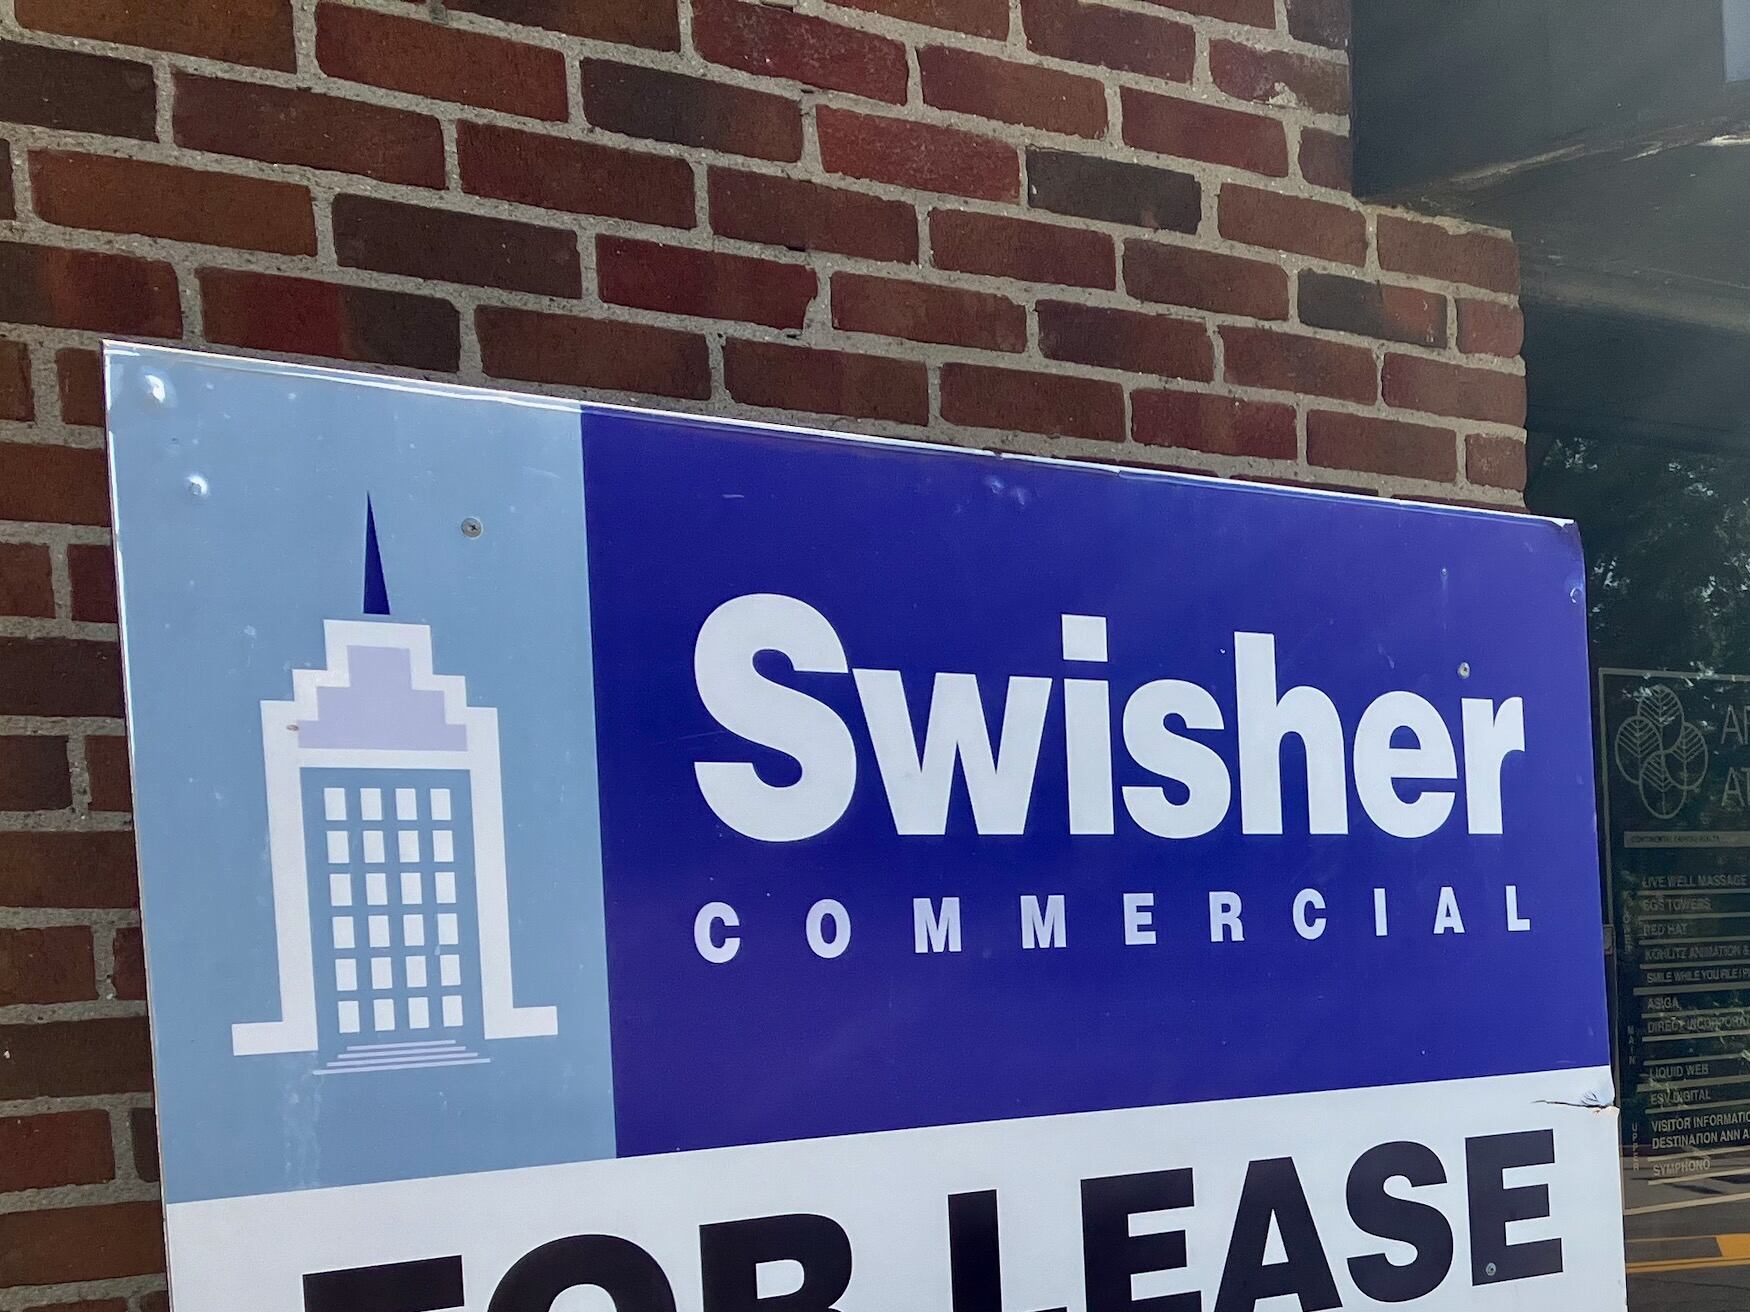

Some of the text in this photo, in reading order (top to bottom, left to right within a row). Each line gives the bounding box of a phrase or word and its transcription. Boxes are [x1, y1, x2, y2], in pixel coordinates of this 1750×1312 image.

[694, 593, 1526, 842] Swisher
[1667, 875, 1697, 888] WELL
[1698, 874, 1748, 887] MASSAGE
[1667, 897, 1712, 911] TOWERS
[693, 885, 1531, 964] COMMERCIAL
[1667, 923, 1688, 935] HAT
[1647, 972, 1672, 984] SMILE
[1674, 970, 1700, 982] WHILE
[1701, 969, 1720, 981] YOU
[1650, 1064, 1684, 1080] LIQUID
[1685, 1063, 1709, 1076] WEB
[1673, 1088, 1711, 1103] DIGITAL
[1651, 1116, 1690, 1133] VISITOR
[1652, 1131, 1718, 1150] DESTINATION
[1719, 1128, 1741, 1142] ANN
